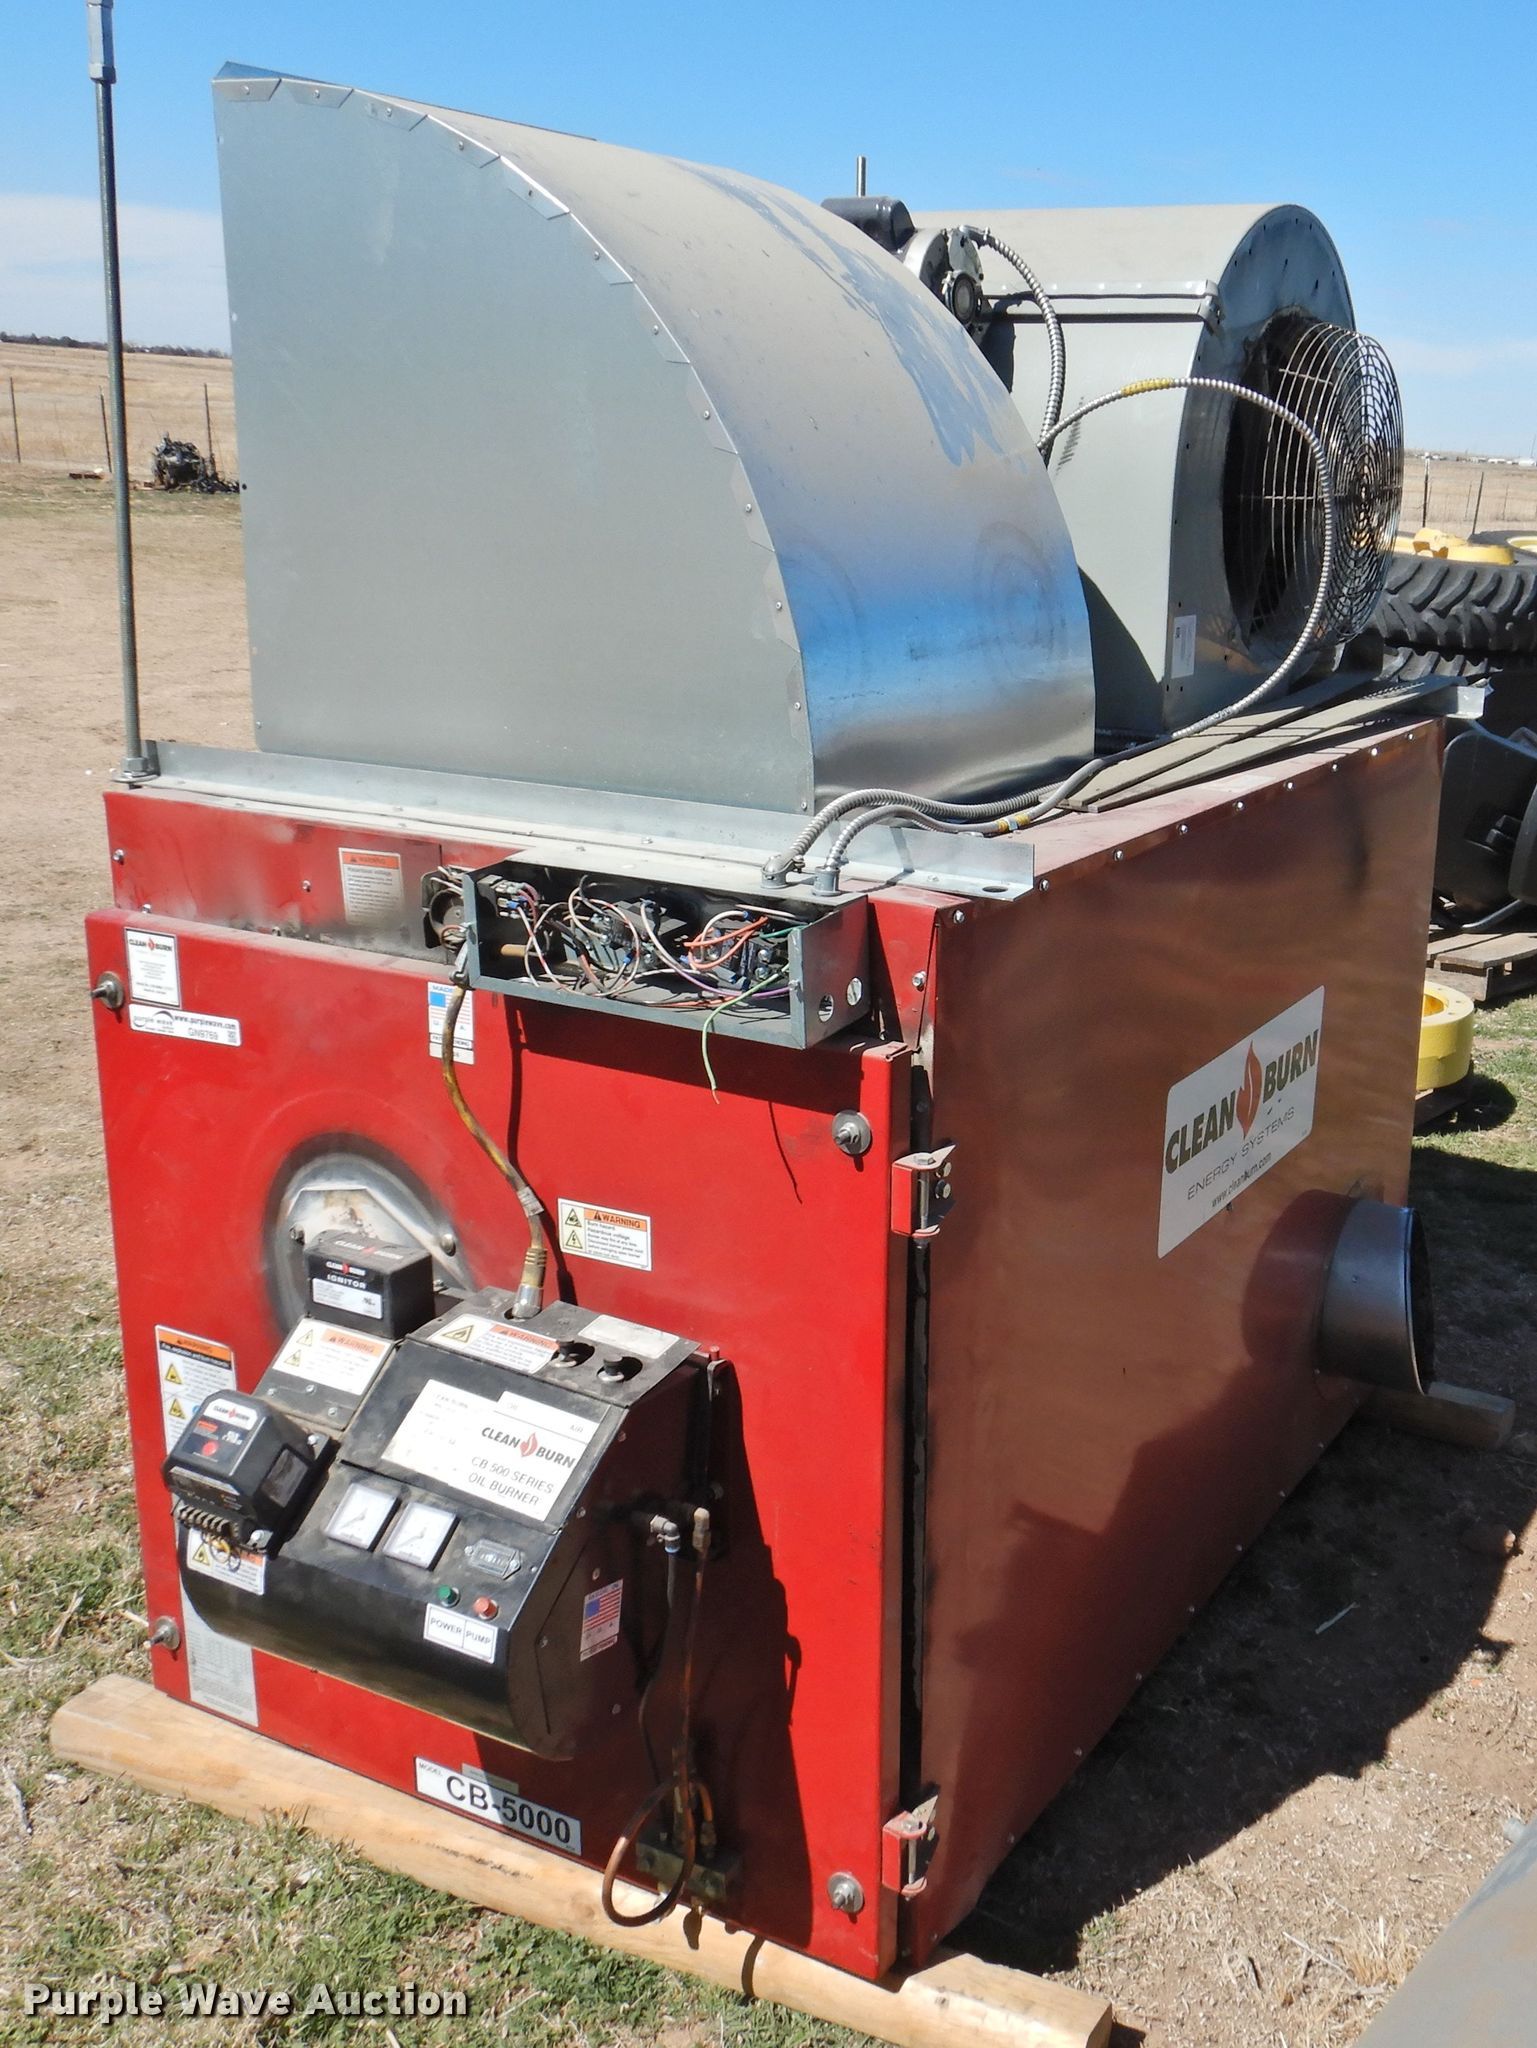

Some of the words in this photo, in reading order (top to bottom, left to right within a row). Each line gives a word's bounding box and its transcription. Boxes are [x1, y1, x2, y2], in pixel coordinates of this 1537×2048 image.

[1165, 1090, 1236, 1175] CLEAN
[1262, 1029, 1319, 1104] BURN
[1187, 1152, 1238, 1200] ENERGY
[1241, 1106, 1296, 1157] SYSTEMS
[602, 1213, 641, 1229] WARNING
[327, 1274, 366, 1289] IGNITOR
[481, 1427, 521, 1448] CLEAN
[535, 1446, 577, 1468] BURN
[468, 1472, 486, 1487] OIL
[489, 1480, 540, 1506] BURNER
[471, 1456, 489, 1469] CB
[489, 1462, 511, 1477] 500
[513, 1471, 555, 1494] SERIES
[430, 1617, 462, 1633] POWER
[466, 1630, 491, 1644] PUMP
[446, 1776, 571, 1844] CB-5000
